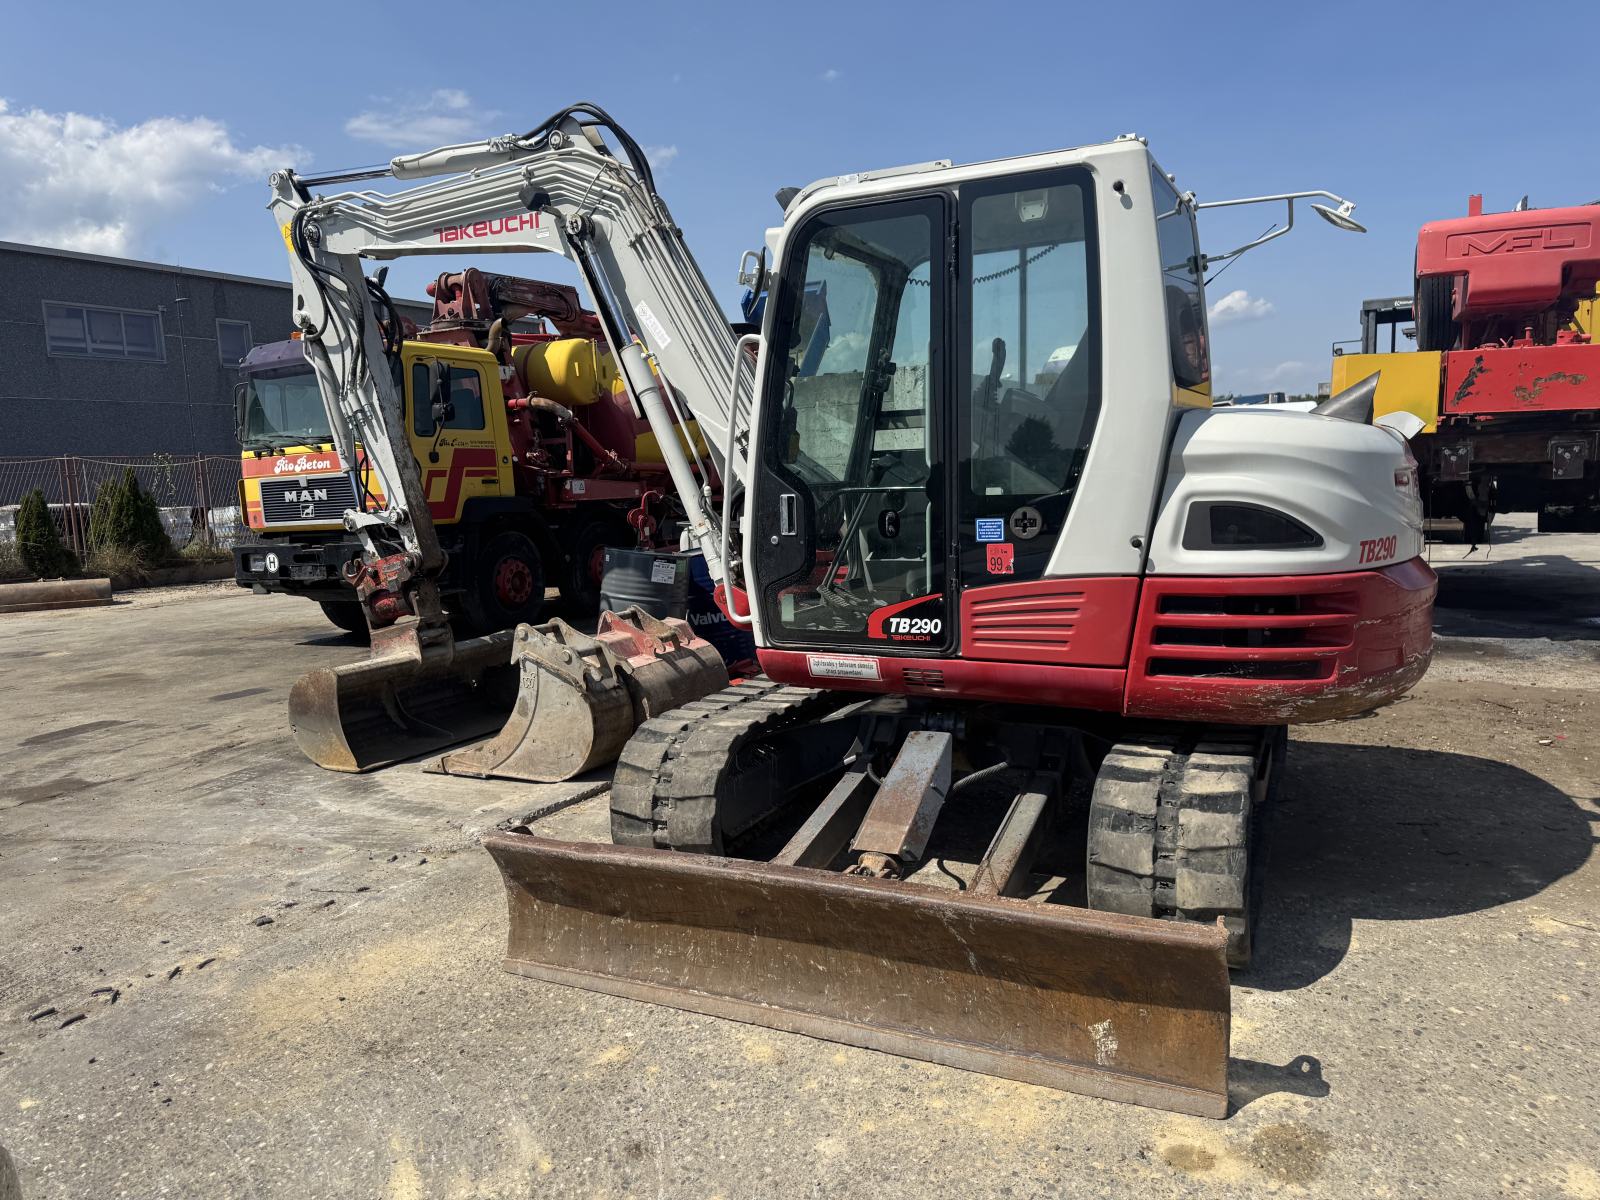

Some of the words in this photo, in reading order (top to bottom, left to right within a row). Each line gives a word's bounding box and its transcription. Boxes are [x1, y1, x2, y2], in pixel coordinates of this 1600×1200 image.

[1461, 228, 1575, 256] MFL
[274, 457, 294, 474] Rio
[295, 456, 331, 472] Beton
[284, 488, 328, 503] MAN
[1359, 534, 1397, 564] TB290
[990, 556, 1003, 571] 99
[889, 617, 942, 634] TB290
